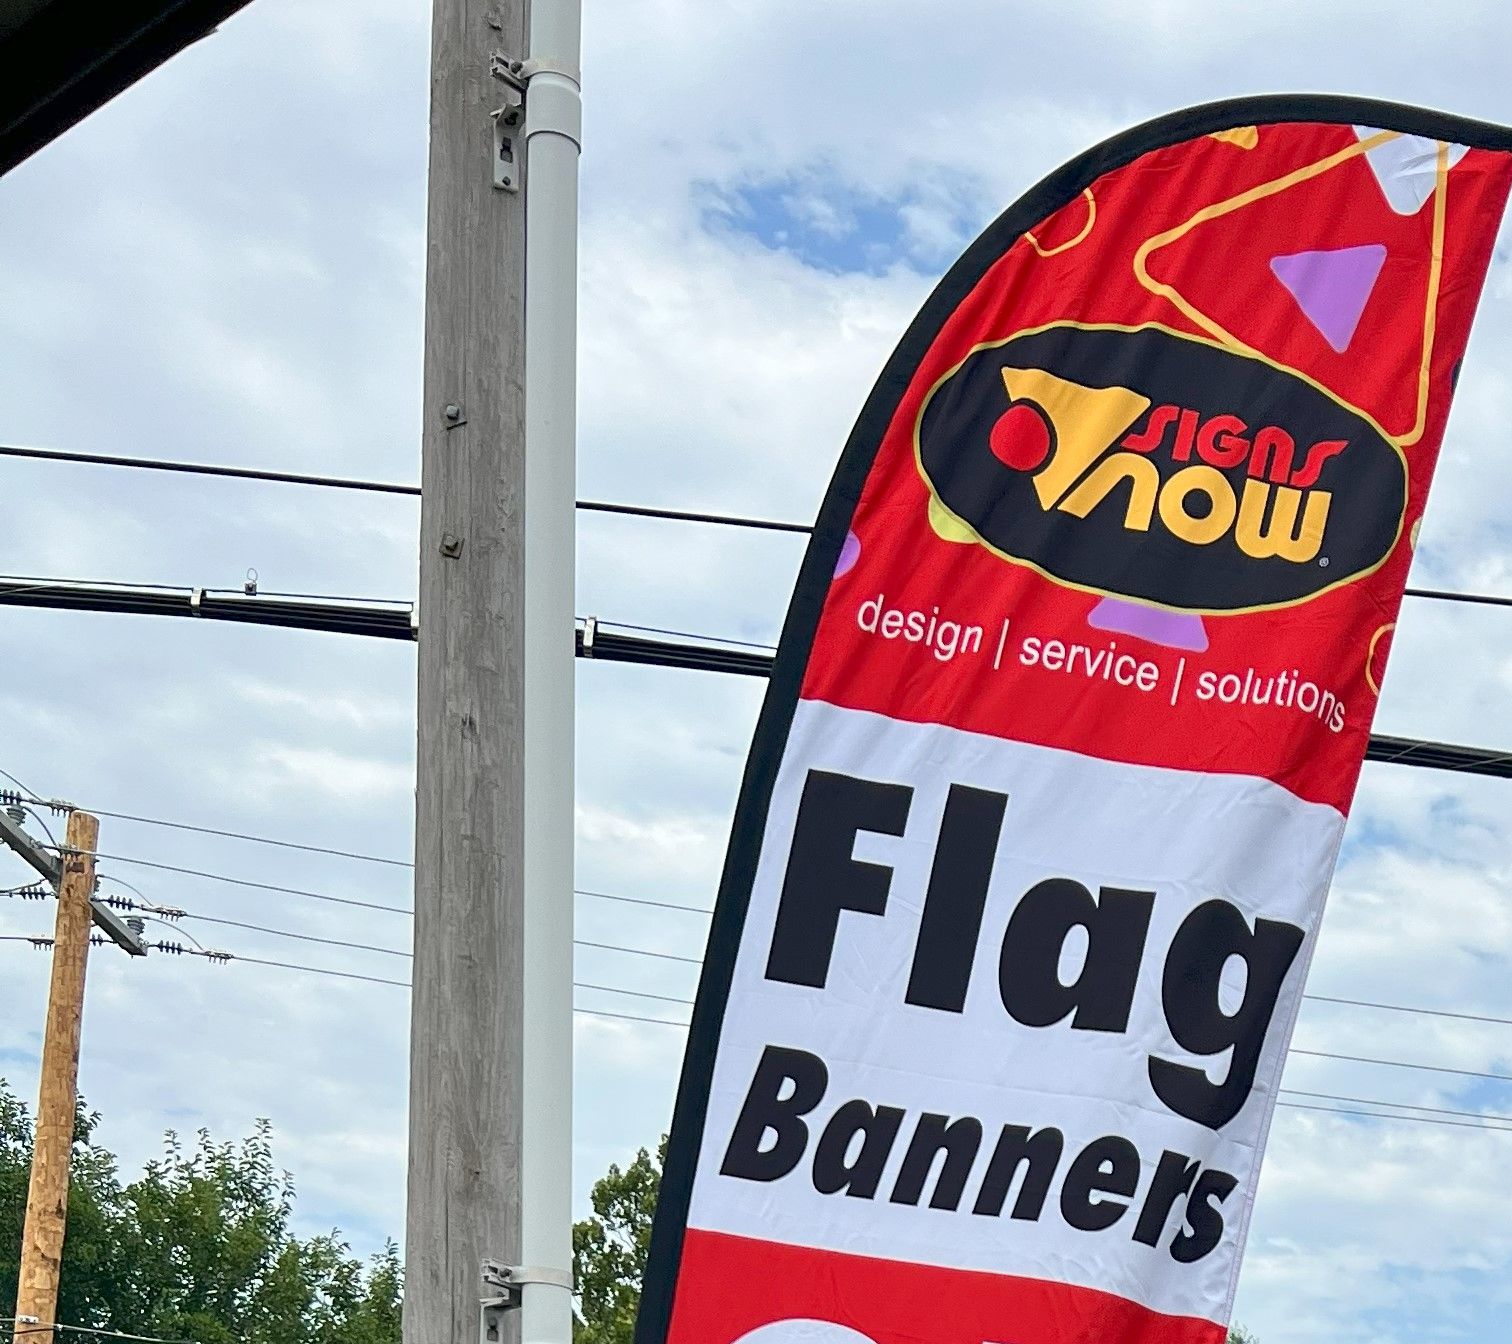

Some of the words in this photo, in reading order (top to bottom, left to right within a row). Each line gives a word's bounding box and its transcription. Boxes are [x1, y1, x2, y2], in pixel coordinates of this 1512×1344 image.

[856, 593, 984, 660] design
[1018, 631, 1160, 692] service
[1195, 669, 1347, 733] solutions
[764, 769, 1306, 1132] Flag
[719, 1044, 1240, 1263] Banners
